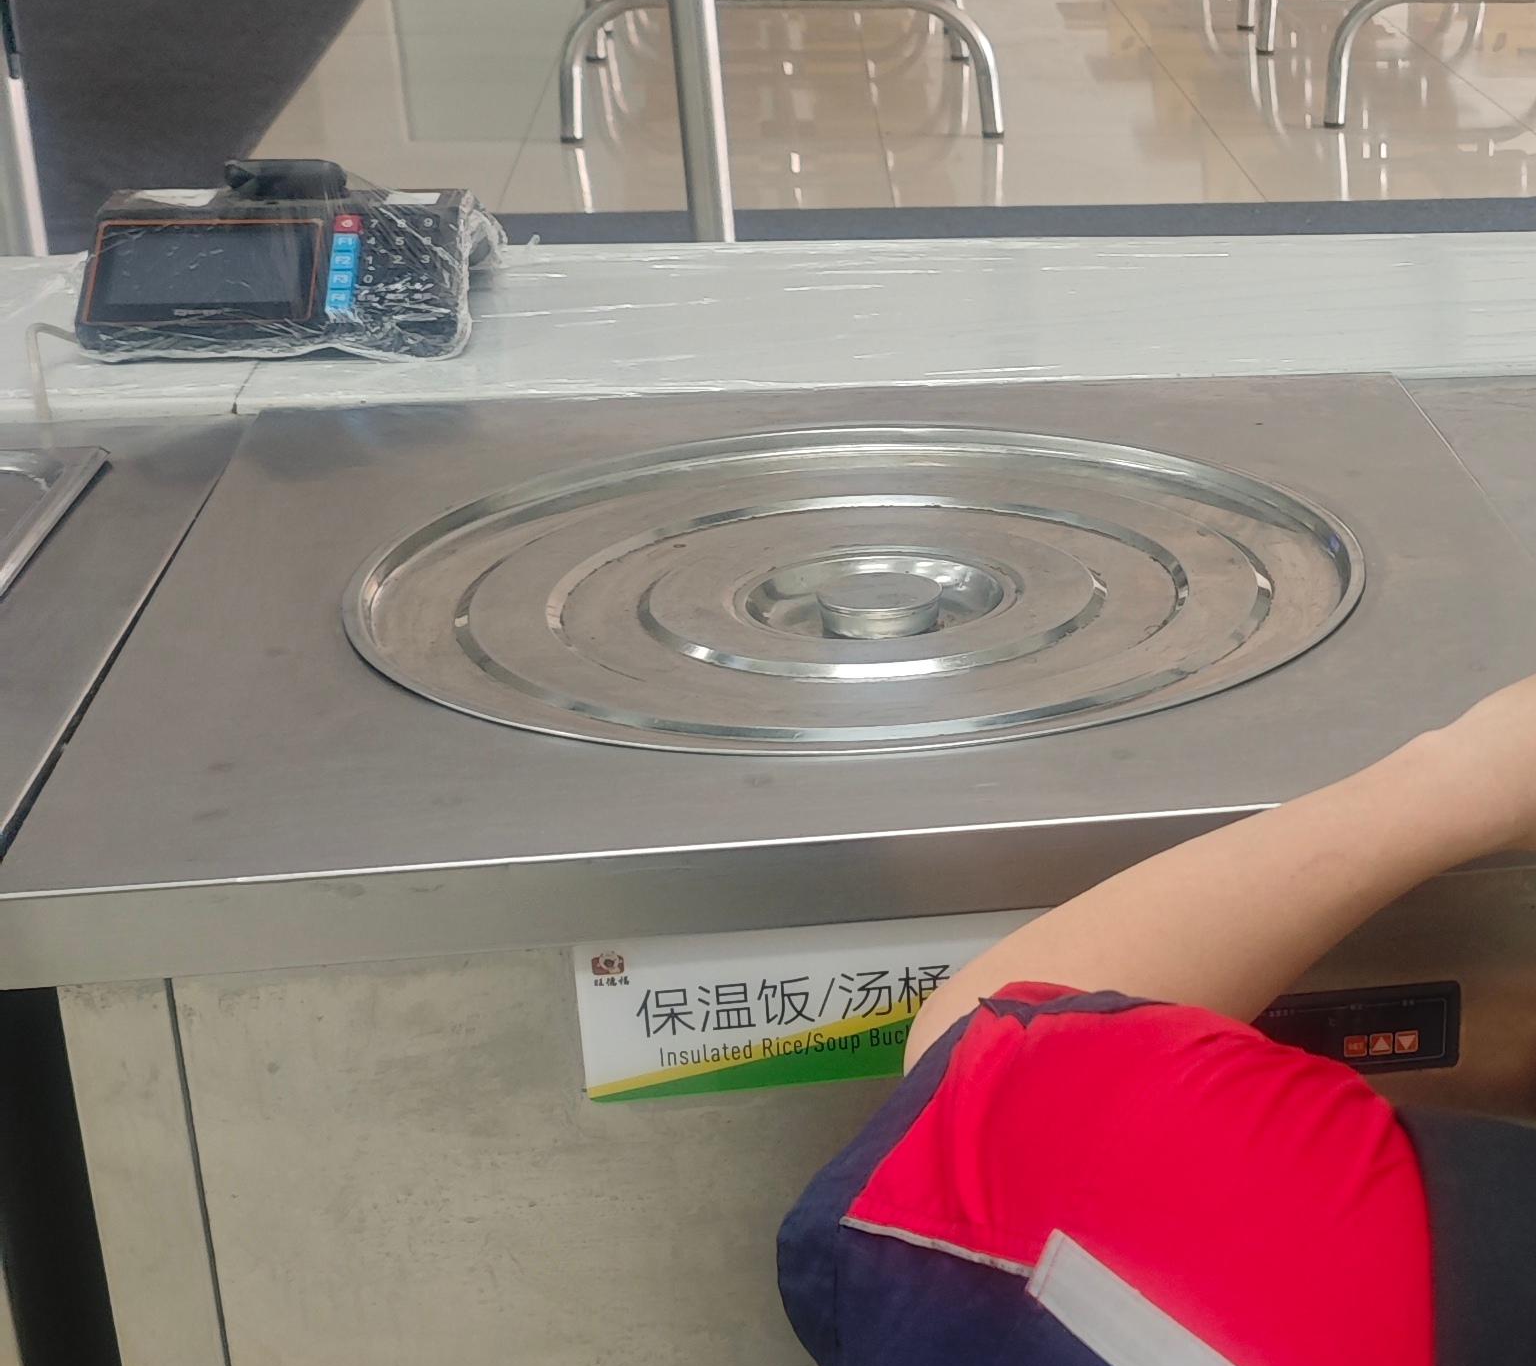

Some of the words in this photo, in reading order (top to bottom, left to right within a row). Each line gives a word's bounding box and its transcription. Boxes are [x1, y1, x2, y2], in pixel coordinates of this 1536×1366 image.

[370, 218, 379, 228] 7
[423, 217, 434, 227] 9
[366, 236, 376, 245] 4
[395, 236, 405, 245] 5
[335, 255, 351, 265] F2
[393, 255, 405, 264] 2
[420, 255, 431, 263] 3
[363, 275, 373, 283] 0
[659, 1039, 753, 1067] Insulated
[762, 1031, 861, 1058] Rice/Soup
